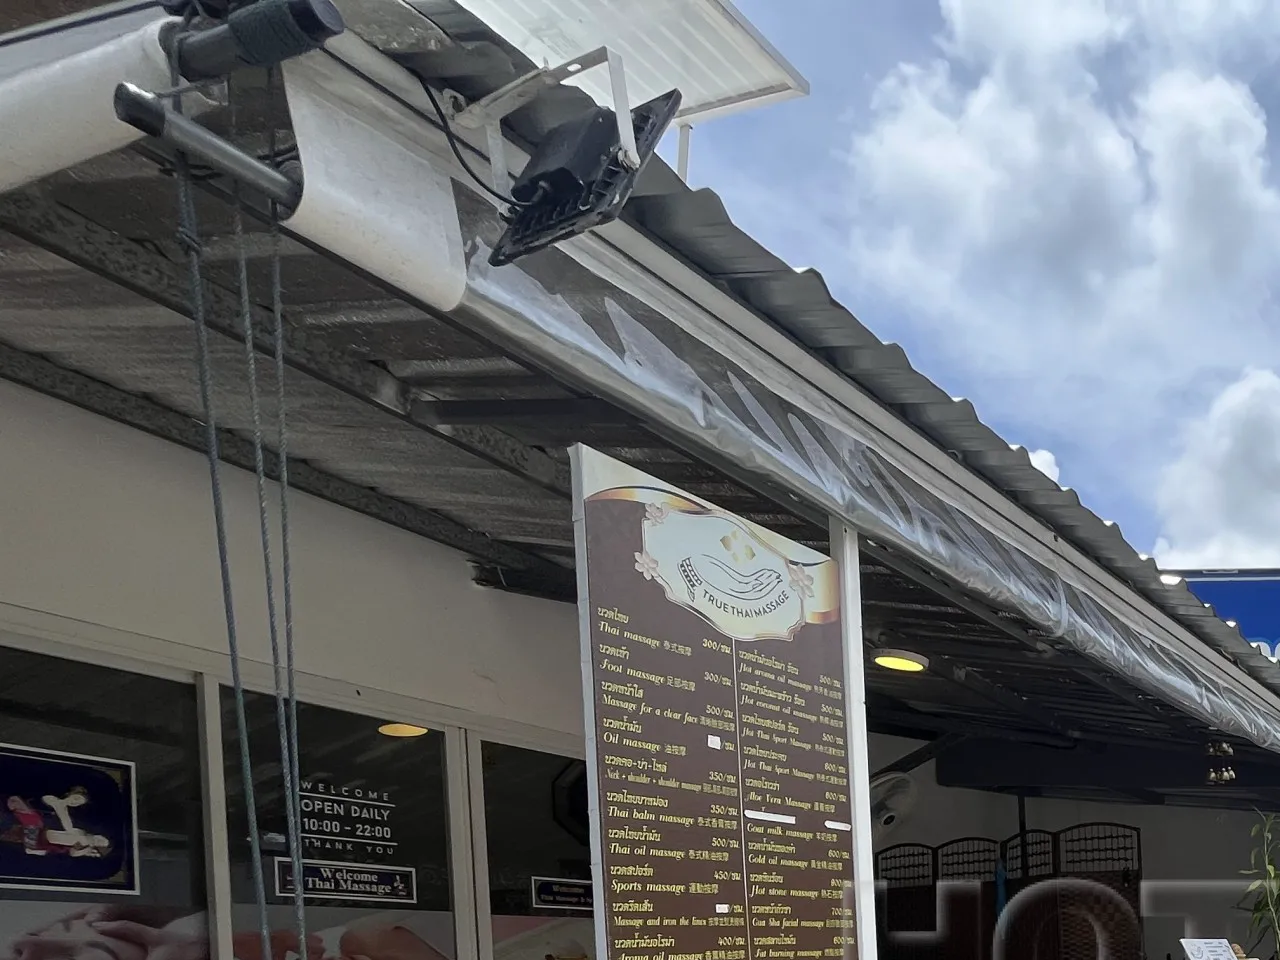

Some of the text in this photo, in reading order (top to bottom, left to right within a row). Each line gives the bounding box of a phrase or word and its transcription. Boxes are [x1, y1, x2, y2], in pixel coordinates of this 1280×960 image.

[599, 621, 660, 649] Thai massage
[600, 659, 665, 685] Foot massage
[738, 663, 752, 673] Hot
[755, 669, 775, 680] aroma
[777, 675, 785, 683] oil
[602, 694, 637, 713] Massage
[639, 703, 652, 714] for
[664, 709, 681, 719] clear
[683, 712, 697, 724] face
[740, 695, 753, 705] Hot
[604, 732, 661, 754] Oil massage
[742, 727, 811, 750] Hot Thai Sport Massage
[744, 759, 755, 769] Hot
[760, 761, 772, 771] Thai
[775, 765, 789, 775] Sport
[792, 768, 814, 781] Massage
[301, 781, 388, 800] WELCOME
[301, 800, 390, 820] OPEN DAILY
[766, 794, 781, 804] Vera
[785, 797, 811, 811] Massage
[608, 806, 694, 827] Thai balm massage
[303, 818, 391, 838] 10:00 22:00
[747, 823, 813, 841] Goat milk massage
[305, 839, 394, 854] THANK YOU
[609, 843, 685, 860] Thai oil massage
[749, 854, 808, 870] Gold oil massage
[320, 868, 378, 882] Welcome
[305, 877, 392, 895] Thai Massage
[611, 879, 685, 895] Sports massage
[750, 885, 818, 900] Hot stone massage
[614, 916, 644, 928] Massage
[647, 917, 660, 925] and
[663, 917, 676, 925] iron
[680, 917, 689, 925] the
[753, 918, 765, 926] Gua
[769, 918, 780, 926] Sha
[801, 921, 824, 930] massage
[756, 949, 766, 958] Fat
[769, 949, 794, 959] burning
[797, 950, 822, 958] massage
